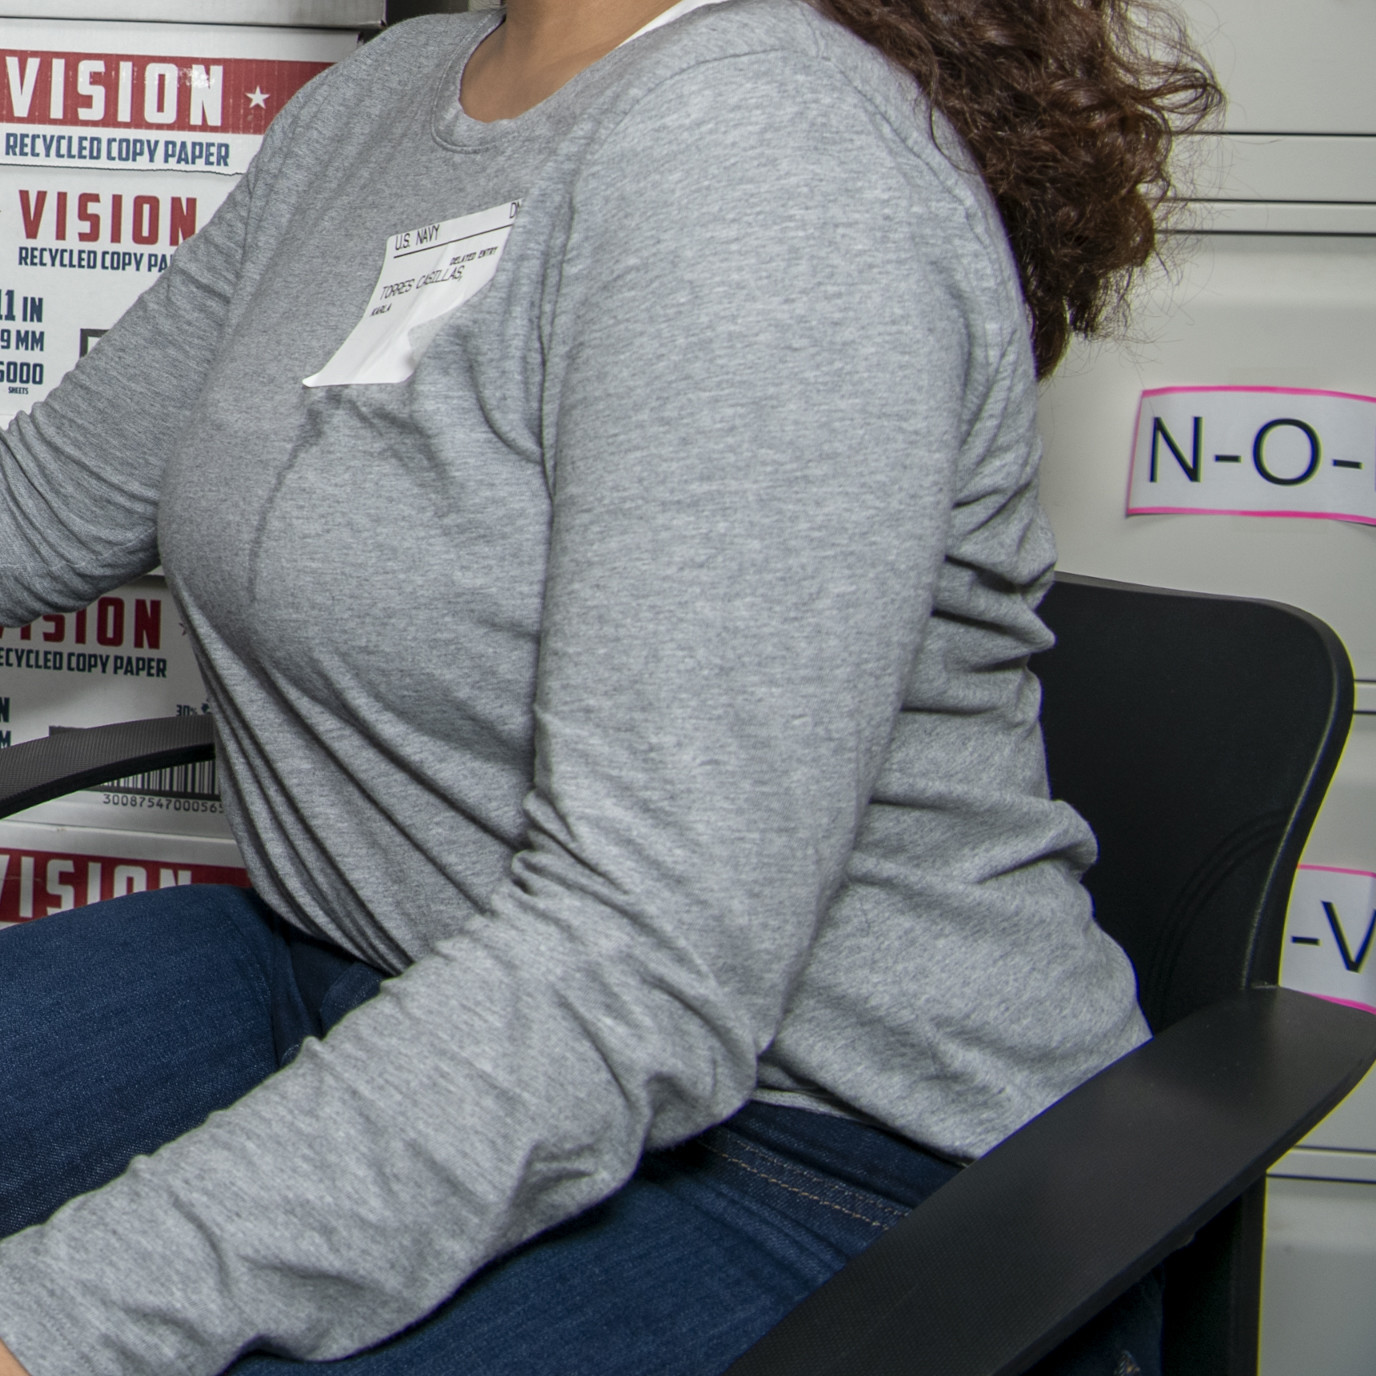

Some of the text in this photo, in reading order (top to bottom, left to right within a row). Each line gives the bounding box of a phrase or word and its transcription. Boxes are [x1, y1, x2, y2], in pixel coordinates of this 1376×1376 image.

[5, 56, 223, 127] VISION
[5, 132, 230, 167] RECYCLED COPY PAPER
[18, 189, 197, 247] VISION
[395, 224, 440, 251] U.S. NAVY
[18, 246, 97, 270] RECYCLED
[101, 250, 144, 272] COPY
[450, 246, 498, 266] DELAYED ENTRY
[380, 279, 413, 301] TORRES
[22, 296, 44, 323] IN
[15, 329, 45, 352] MM
[7, 386, 29, 395] SHEETS
[1149, 416, 1376, 486] N-O-
[67, 652, 109, 675] COPY
[113, 655, 167, 678] PAPER
[102, 792, 226, 815] 30087547000565
